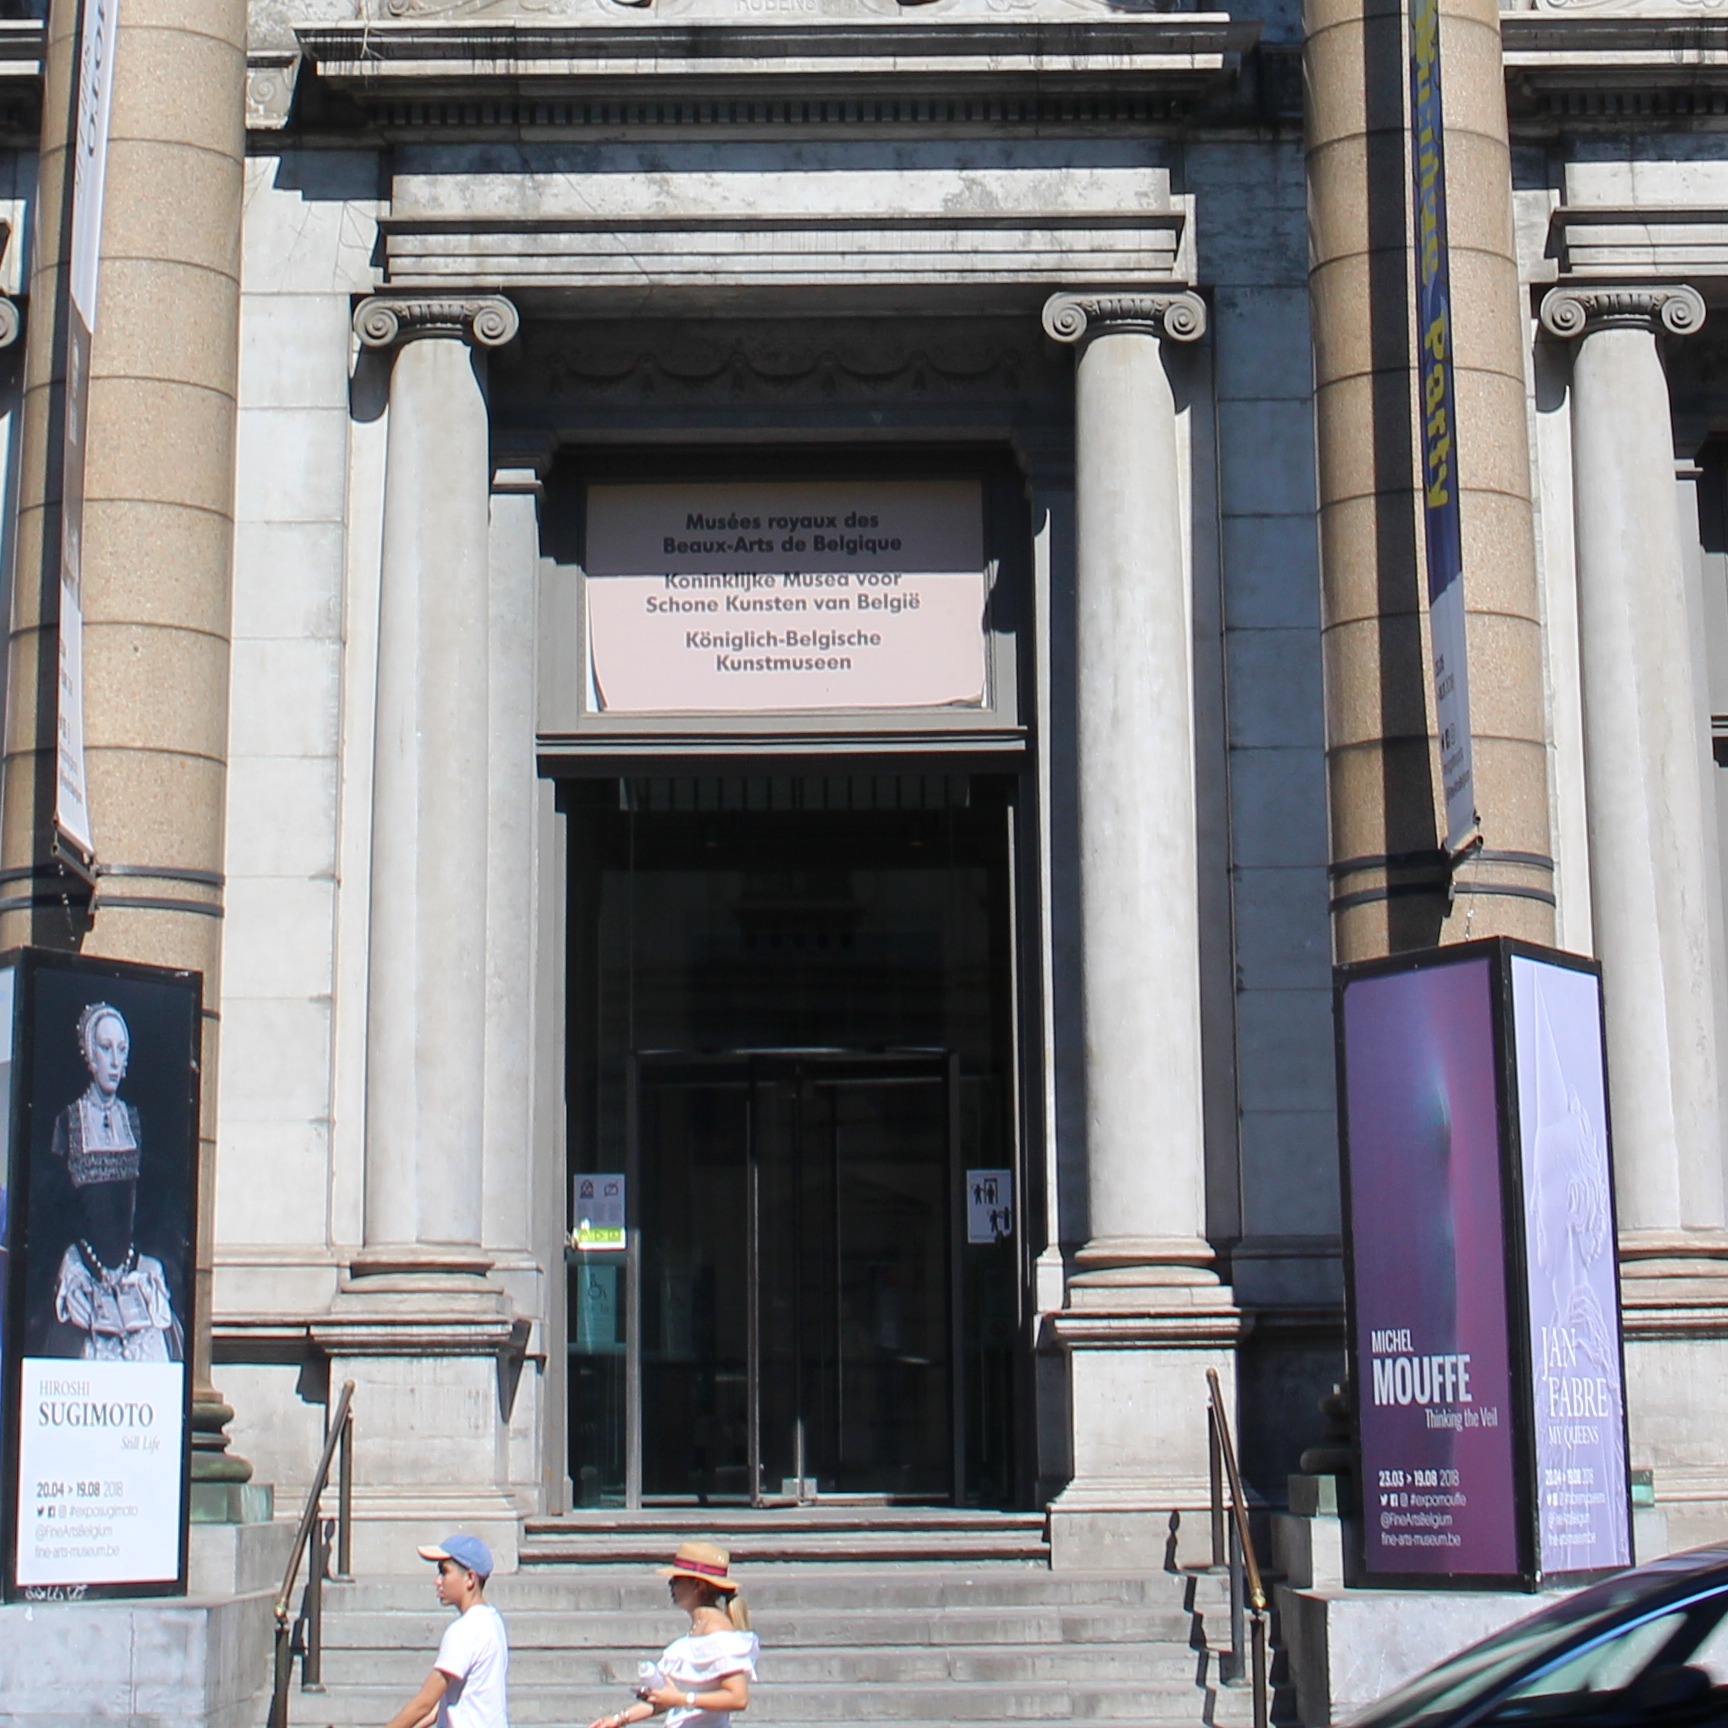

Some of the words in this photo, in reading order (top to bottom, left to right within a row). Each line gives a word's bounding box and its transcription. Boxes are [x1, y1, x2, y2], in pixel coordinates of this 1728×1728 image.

[686, 512, 761, 531] Musées
[768, 515, 838, 535] royaux
[844, 511, 879, 530] des
[663, 536, 773, 555] Beaux-Arts
[781, 535, 807, 554] de
[814, 534, 902, 557] Belgique
[665, 572, 776, 593] Koninklijke
[783, 572, 850, 589] Musea
[856, 572, 902, 588] voor
[646, 595, 719, 614] Schone
[725, 595, 807, 614] Kunsten
[814, 597, 850, 612] van
[857, 592, 921, 614] België
[685, 630, 882, 652] Königlich-Belgische
[716, 654, 852, 673] Kunstmuseen
[1372, 1329, 1414, 1353] MICHEL
[1541, 1326, 1577, 1381] JAN
[39, 1380, 90, 1396] HIROSHI
[1373, 1354, 1473, 1406] MOUFFE
[1549, 1377, 1609, 1418] FABRE
[39, 1402, 153, 1427] SUGIMOTO
[1425, 1408, 1463, 1432] Thinking
[1464, 1407, 1479, 1427] the
[1480, 1407, 1498, 1427] Veil
[121, 1435, 140, 1451] Still
[143, 1435, 161, 1454] Life
[1549, 1426, 1563, 1445] MY
[1564, 1425, 1599, 1449] QUEENS
[1379, 1470, 1404, 1487] 23.03
[1414, 1470, 1437, 1487] 19.08
[1440, 1469, 1460, 1486] 2018
[36, 1481, 65, 1498] 20.04
[77, 1481, 101, 1498] 19.08
[103, 1481, 124, 1497] 2018
[1410, 1492, 1467, 1508] #expomouffe
[69, 1505, 138, 1520] #exposugimoto
